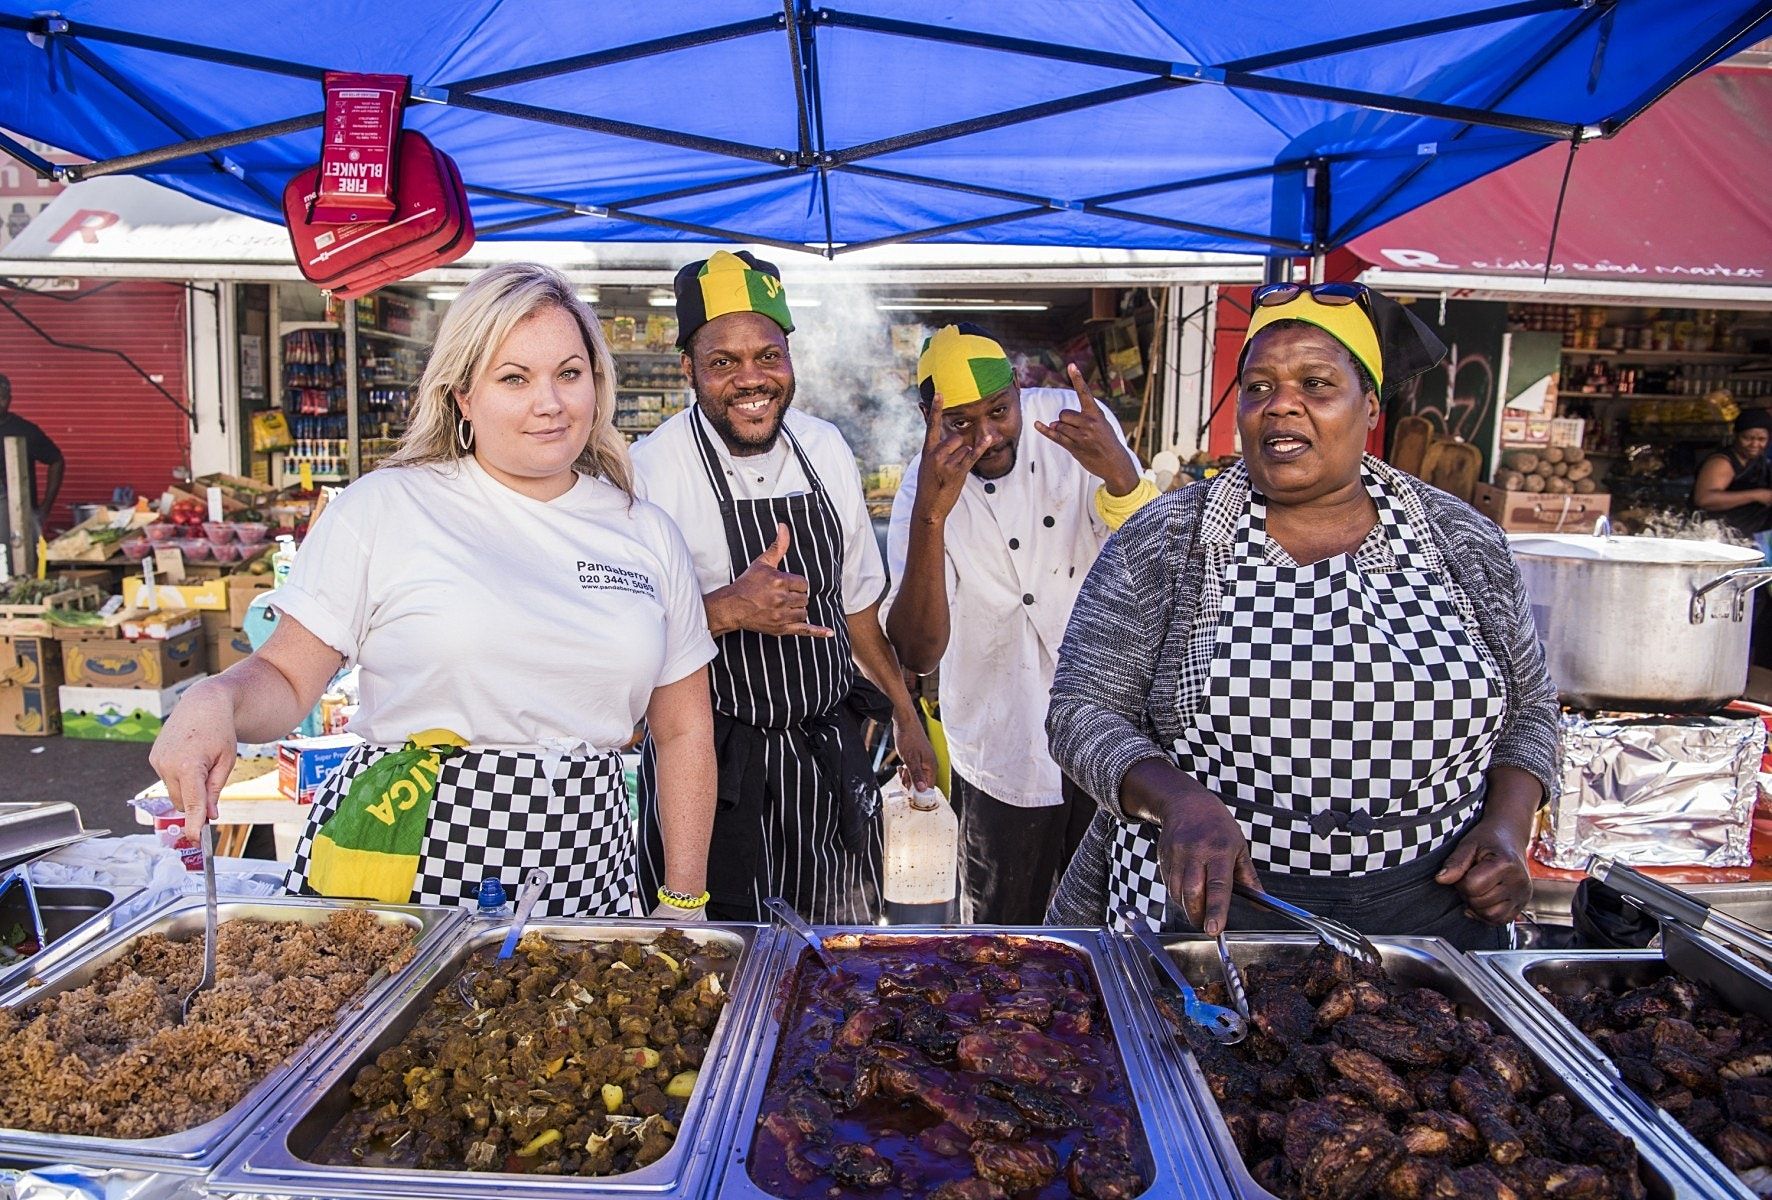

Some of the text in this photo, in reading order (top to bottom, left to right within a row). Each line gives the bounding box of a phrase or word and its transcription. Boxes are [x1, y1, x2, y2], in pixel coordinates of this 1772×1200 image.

[324, 162, 383, 177] BLANKET
[339, 178, 368, 193] FIRE
[48, 209, 121, 244] R
[576, 561, 649, 583] Pandaberry
[579, 575, 654, 592] 020 3441 5089
